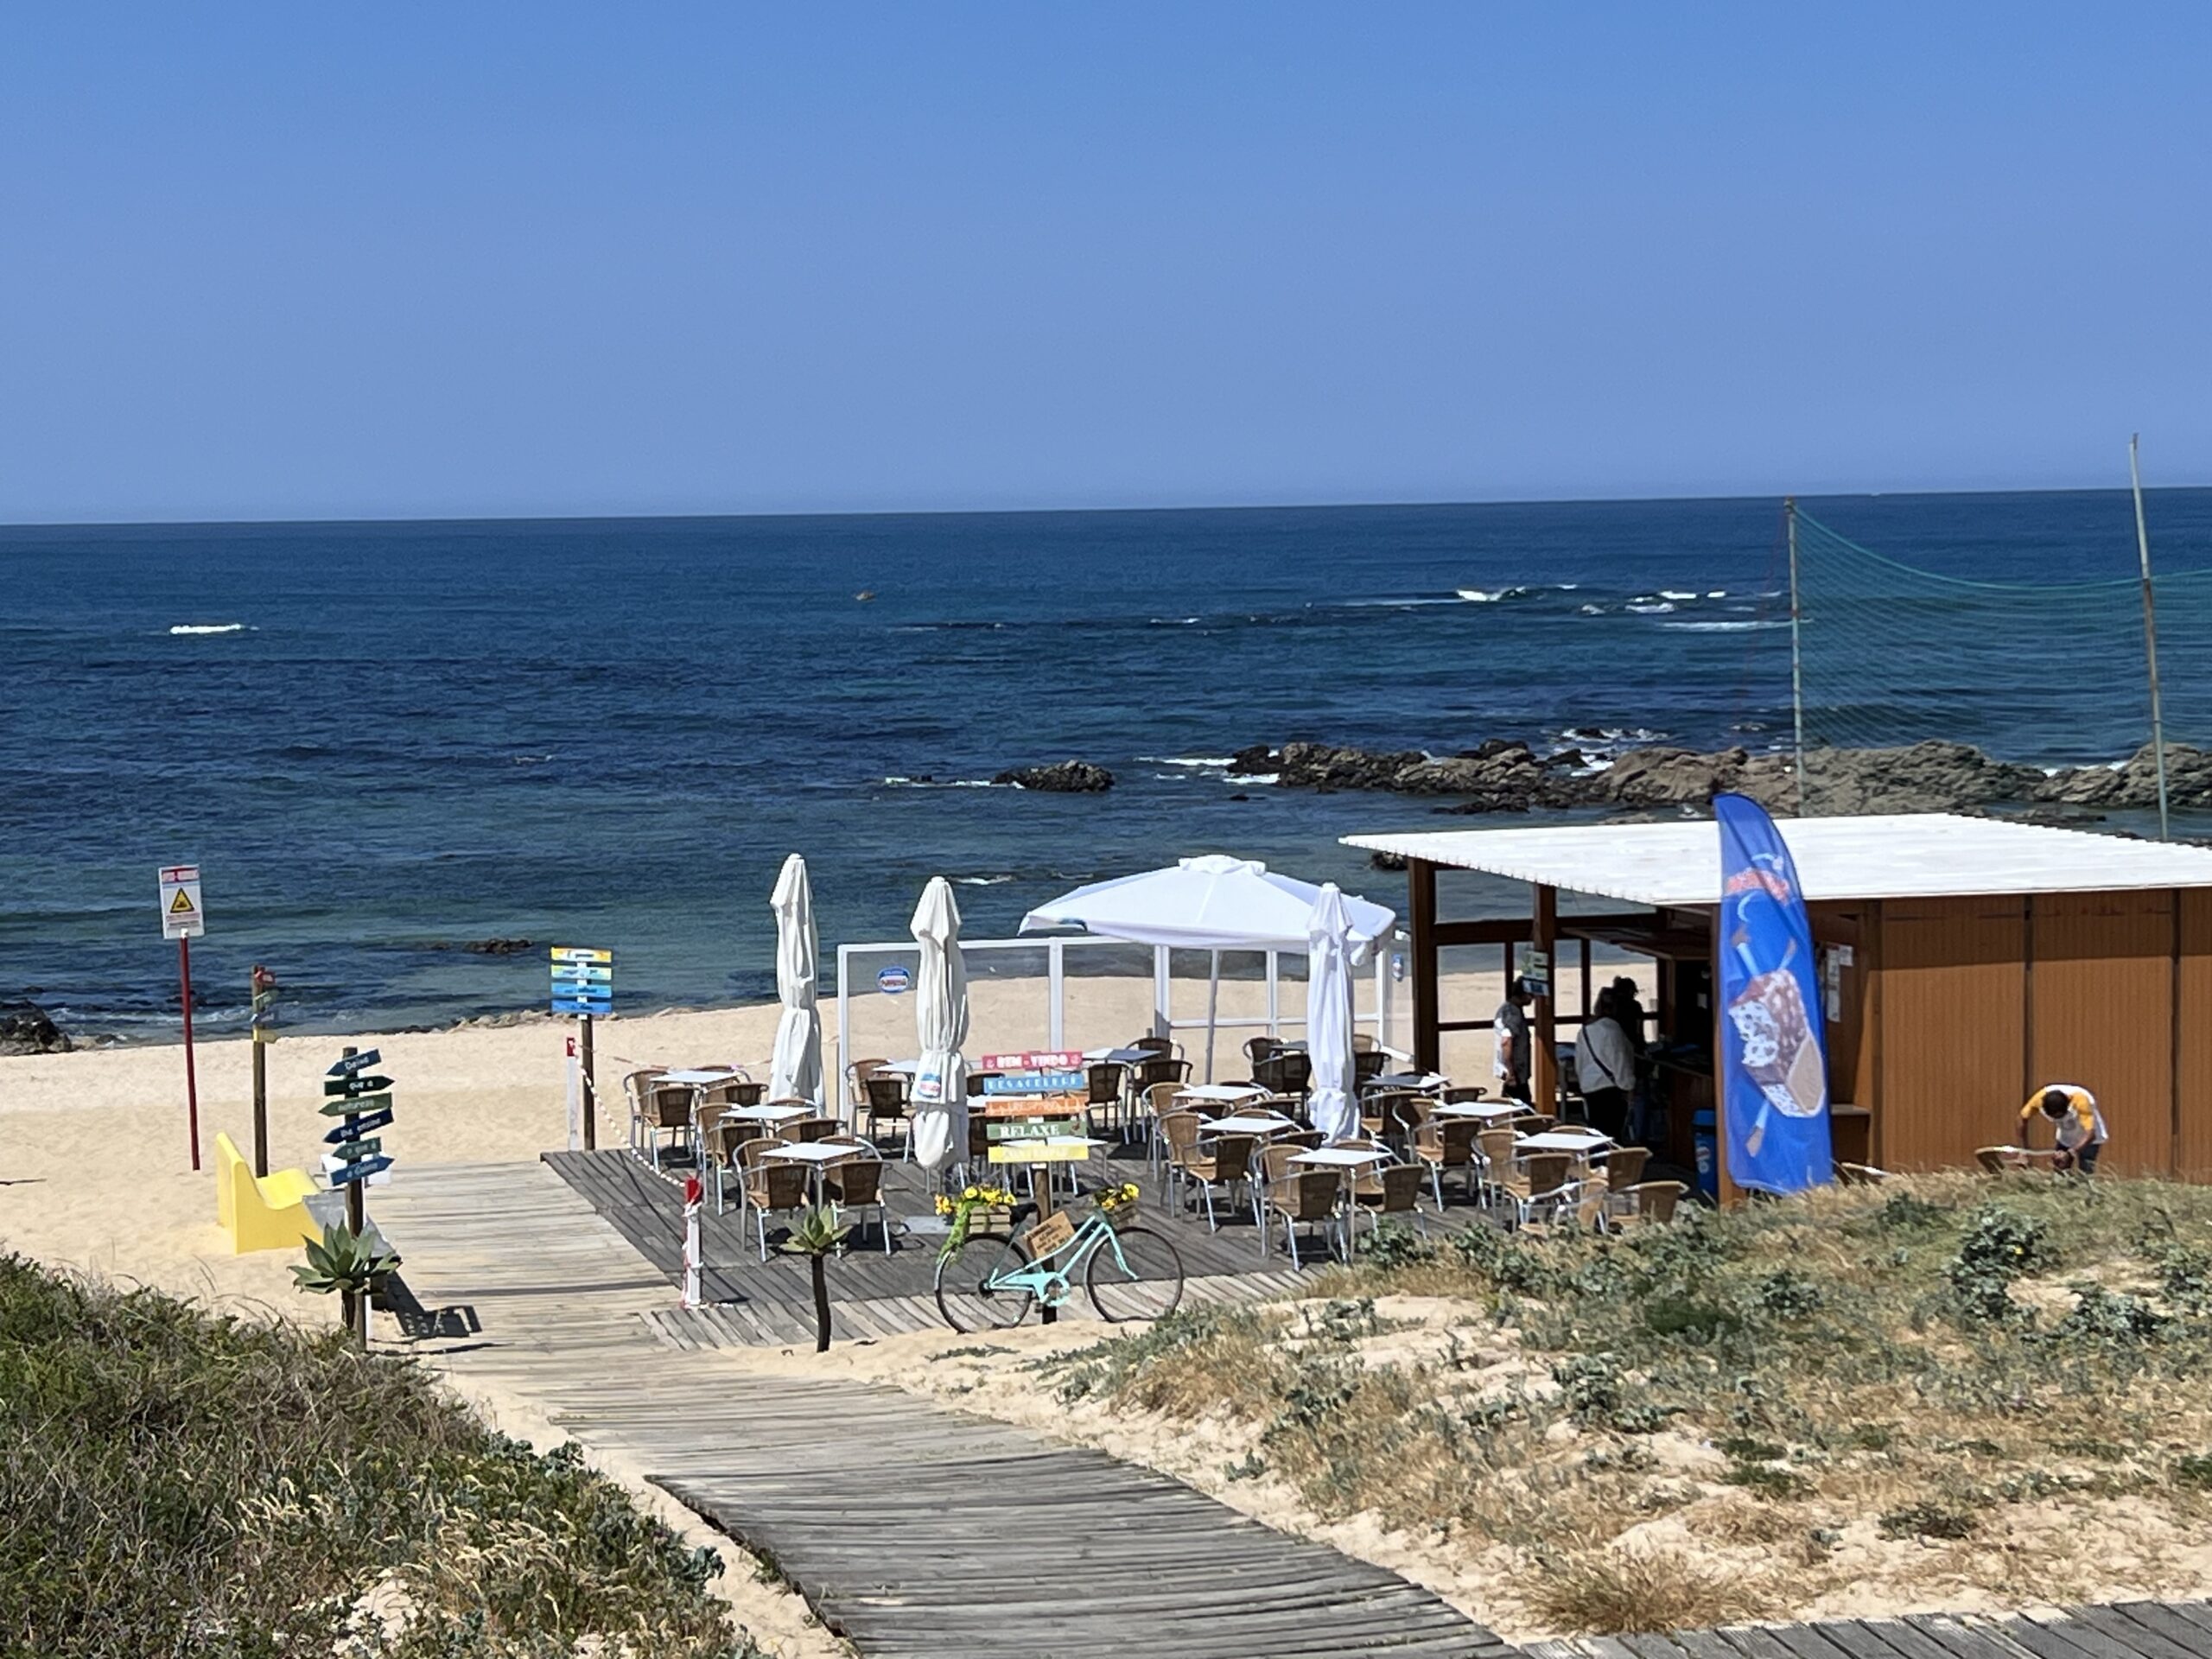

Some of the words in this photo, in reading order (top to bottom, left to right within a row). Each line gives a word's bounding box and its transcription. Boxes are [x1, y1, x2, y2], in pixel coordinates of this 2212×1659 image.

[349, 1081, 364, 1090] que
[338, 1099, 374, 1111] natureza
[1000, 1125, 1059, 1137] RELAXE
